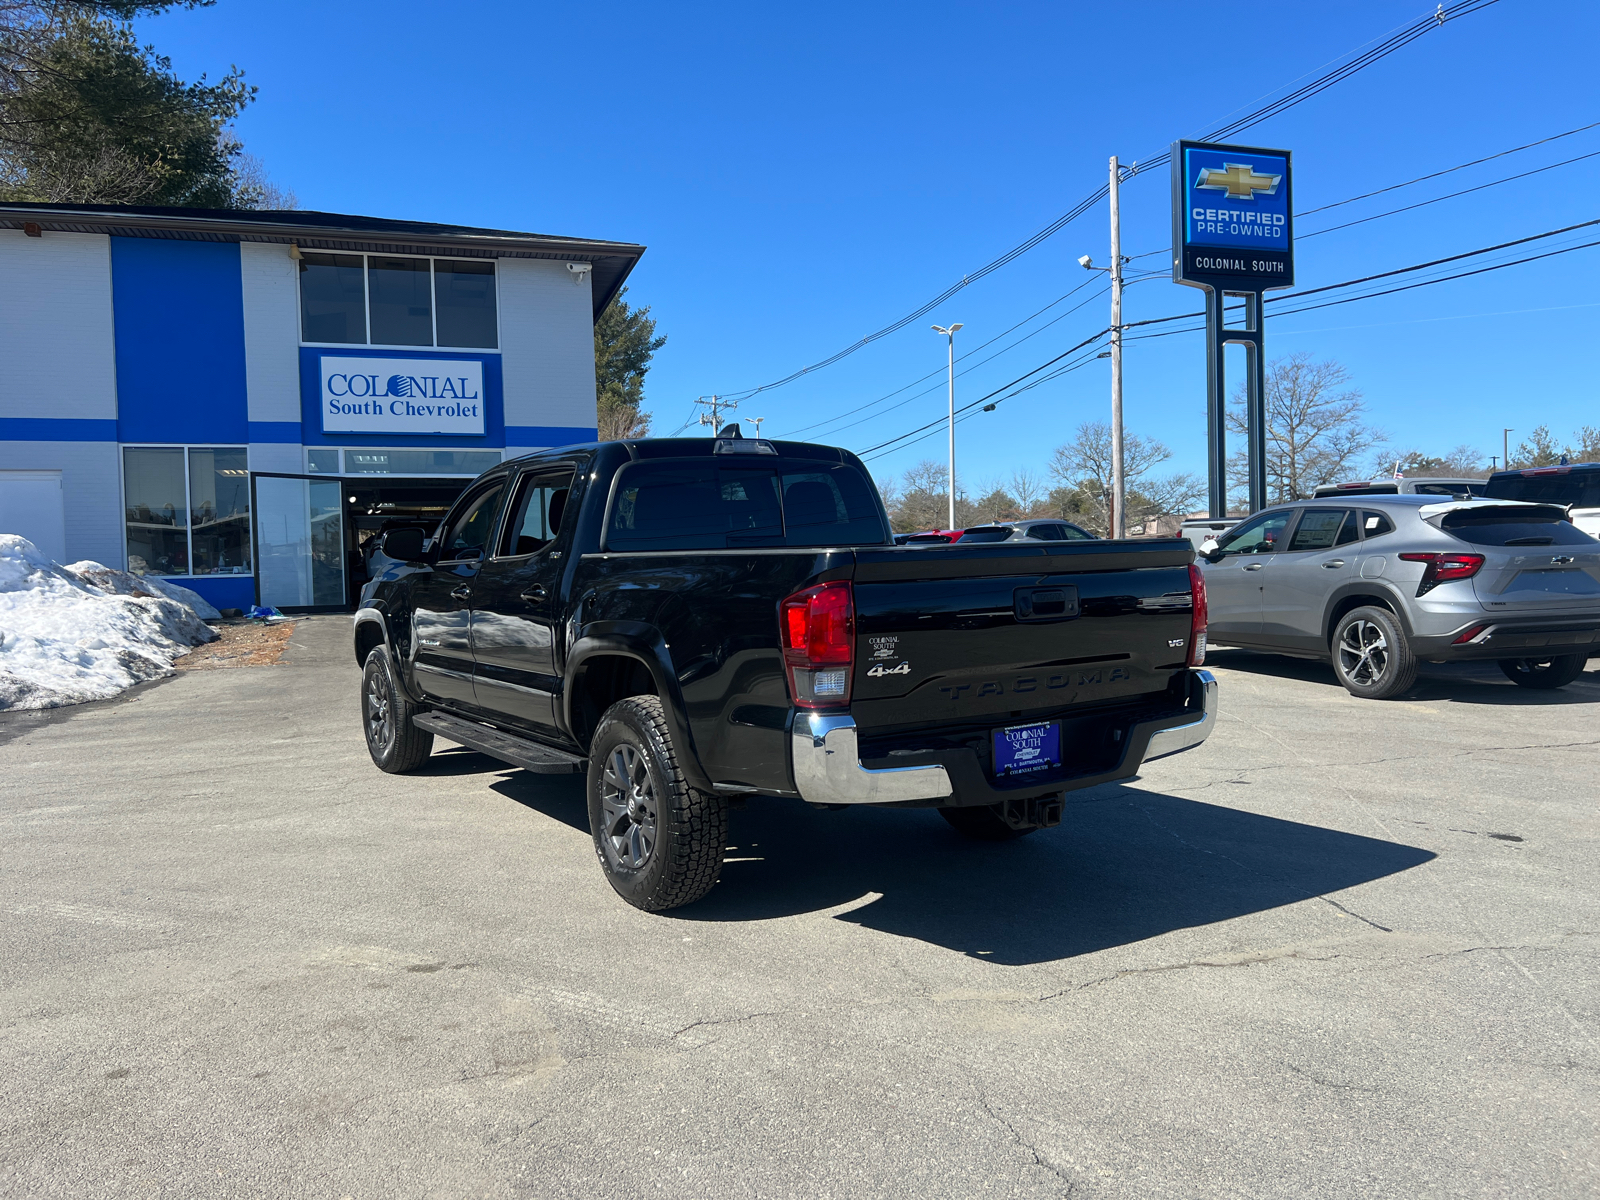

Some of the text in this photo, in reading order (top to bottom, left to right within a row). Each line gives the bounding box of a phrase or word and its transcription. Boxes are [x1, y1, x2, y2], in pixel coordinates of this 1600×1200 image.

[1192, 208, 1285, 225] CERTIFIED
[1197, 222, 1281, 238] PRE-OWNED
[1195, 257, 1284, 273] COLONIAL SOUTH
[327, 373, 478, 400] COLONIAL
[329, 399, 478, 417] South Chevrolet
[868, 636, 900, 644] COLONIAL
[1168, 638, 1184, 647] V6
[867, 661, 912, 677] 4x4
[938, 666, 1131, 700] TACOMA
[1006, 728, 1047, 742] COLONIAL
[1012, 738, 1041, 750] SOUTH
[1016, 750, 1038, 758] CHEVROLET
